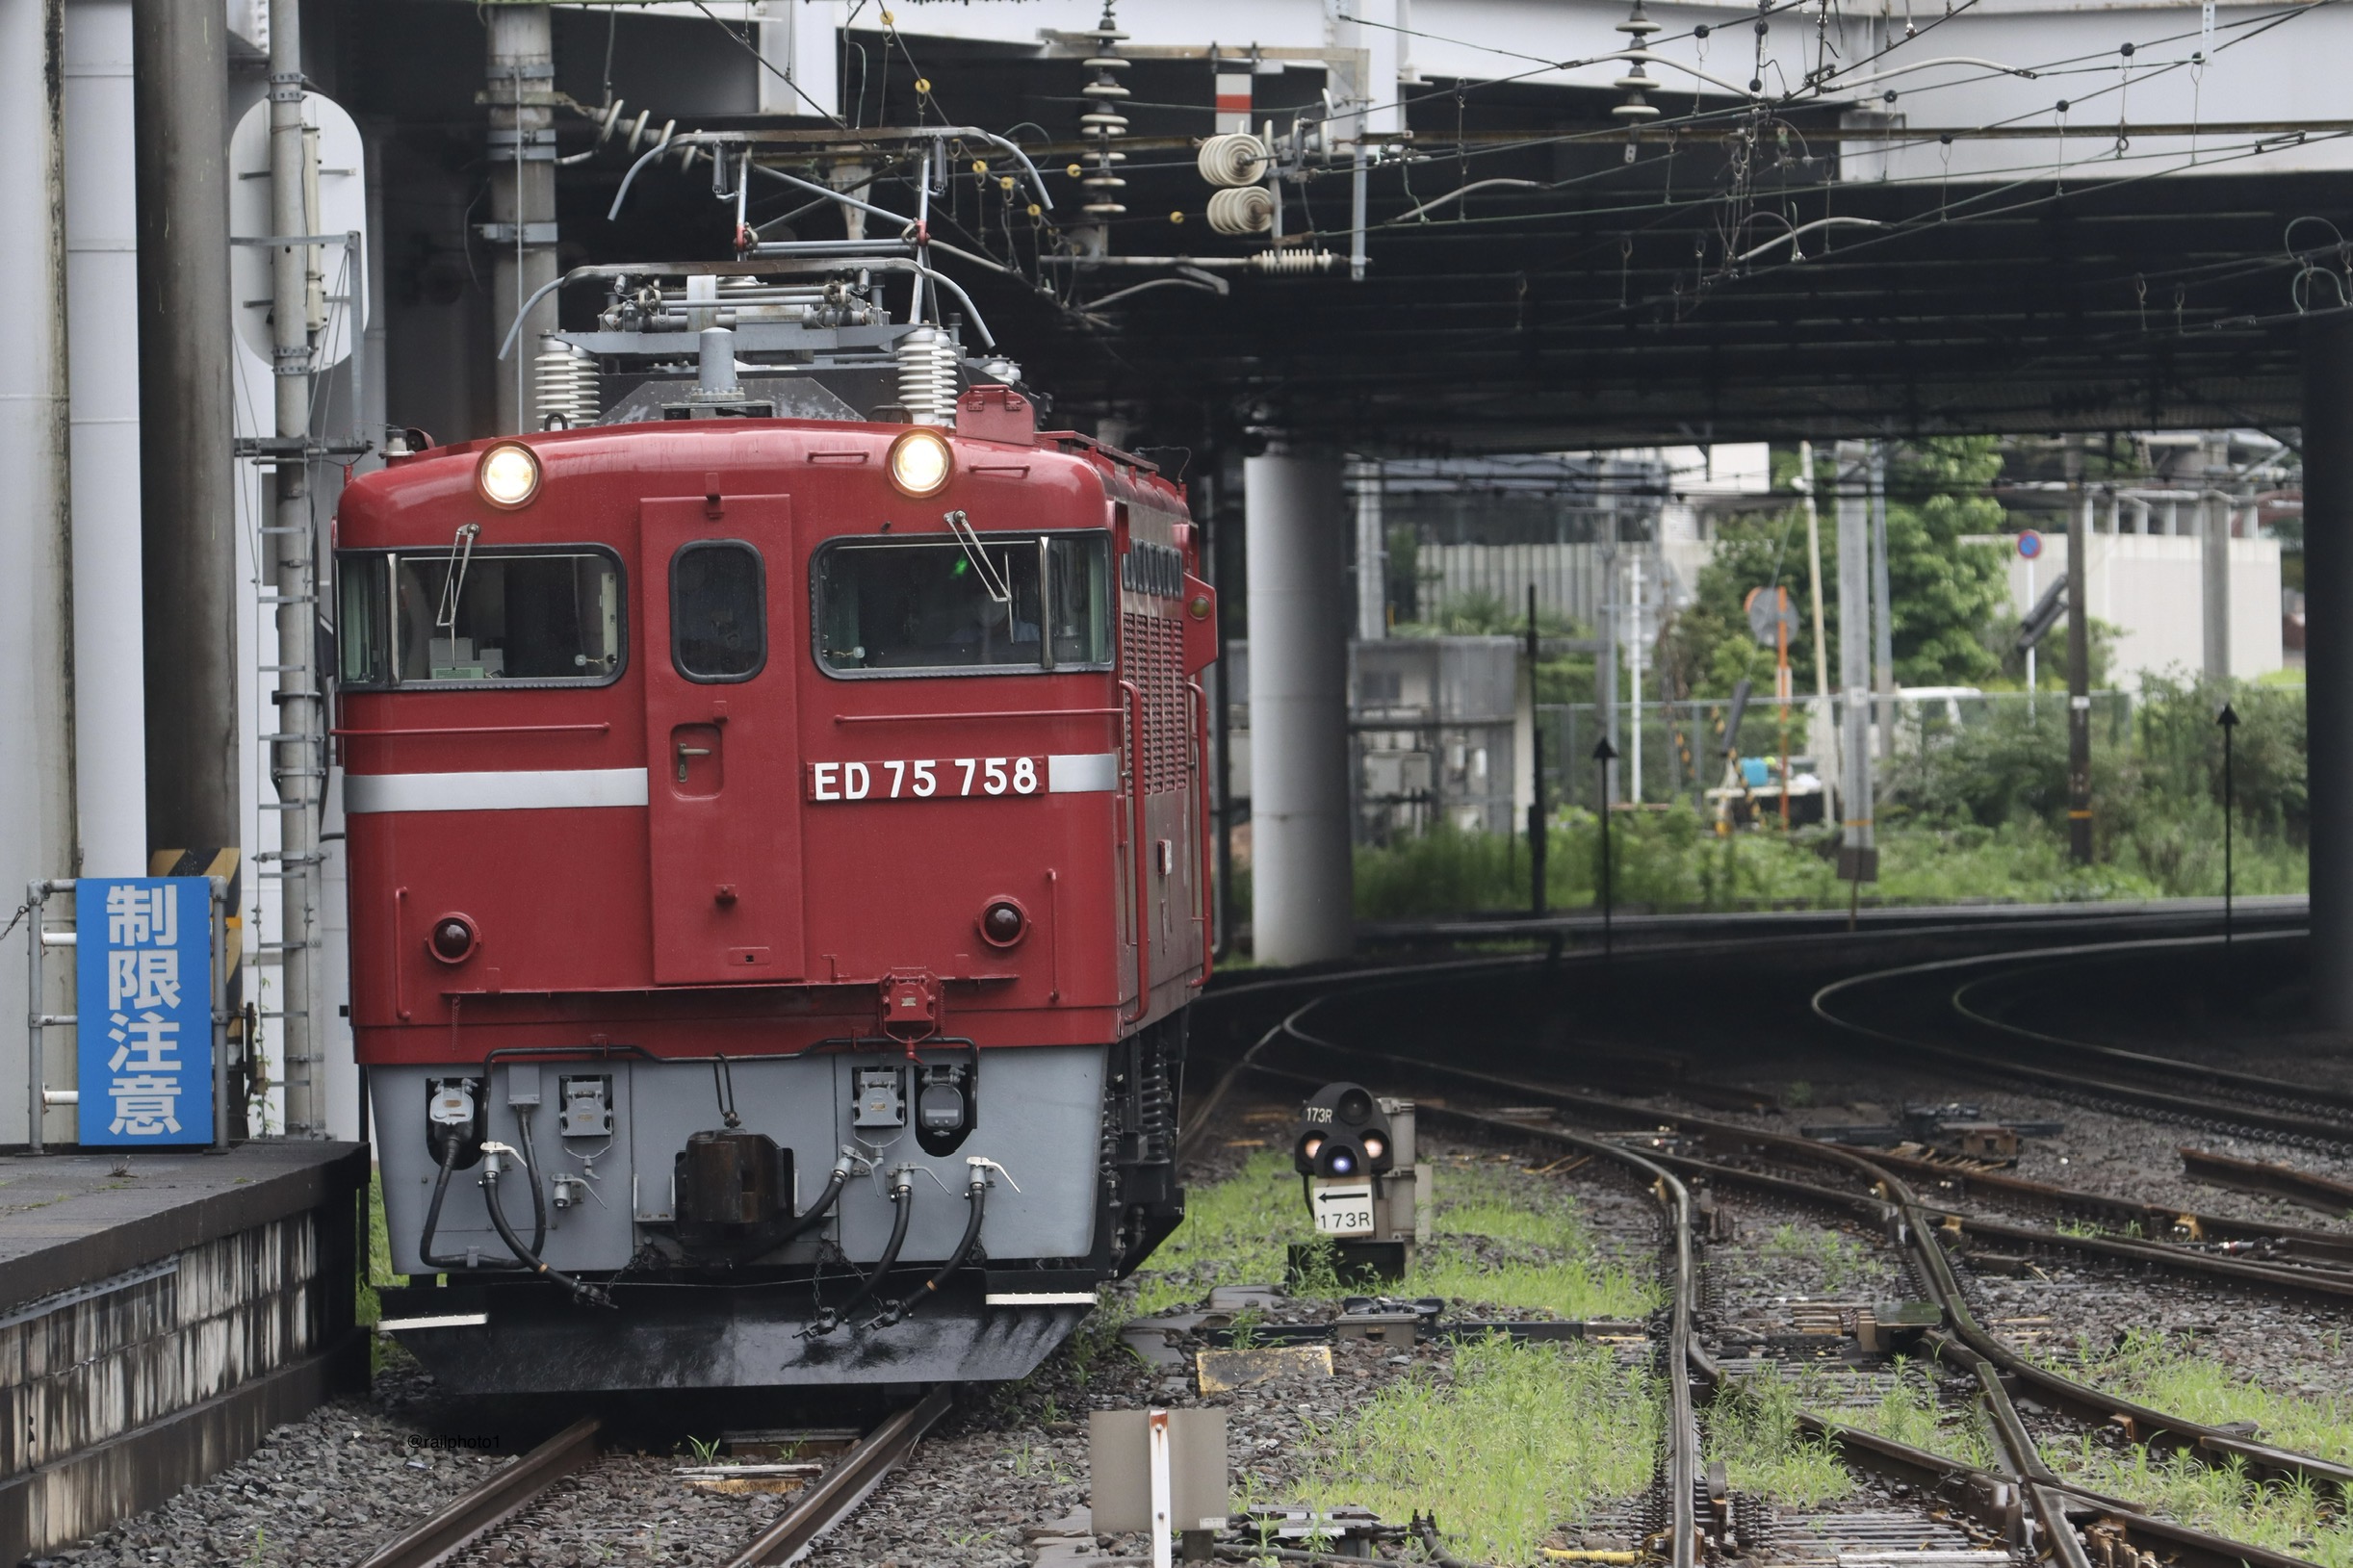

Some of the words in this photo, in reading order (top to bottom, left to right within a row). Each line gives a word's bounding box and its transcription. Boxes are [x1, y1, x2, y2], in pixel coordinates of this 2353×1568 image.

[814, 761, 870, 801] ED
[883, 759, 937, 799] 75
[954, 757, 1038, 797] 758
[106, 884, 183, 1136] 制限注意
[1306, 1106, 1333, 1124] 173R
[1319, 1211, 1371, 1229] 173R
